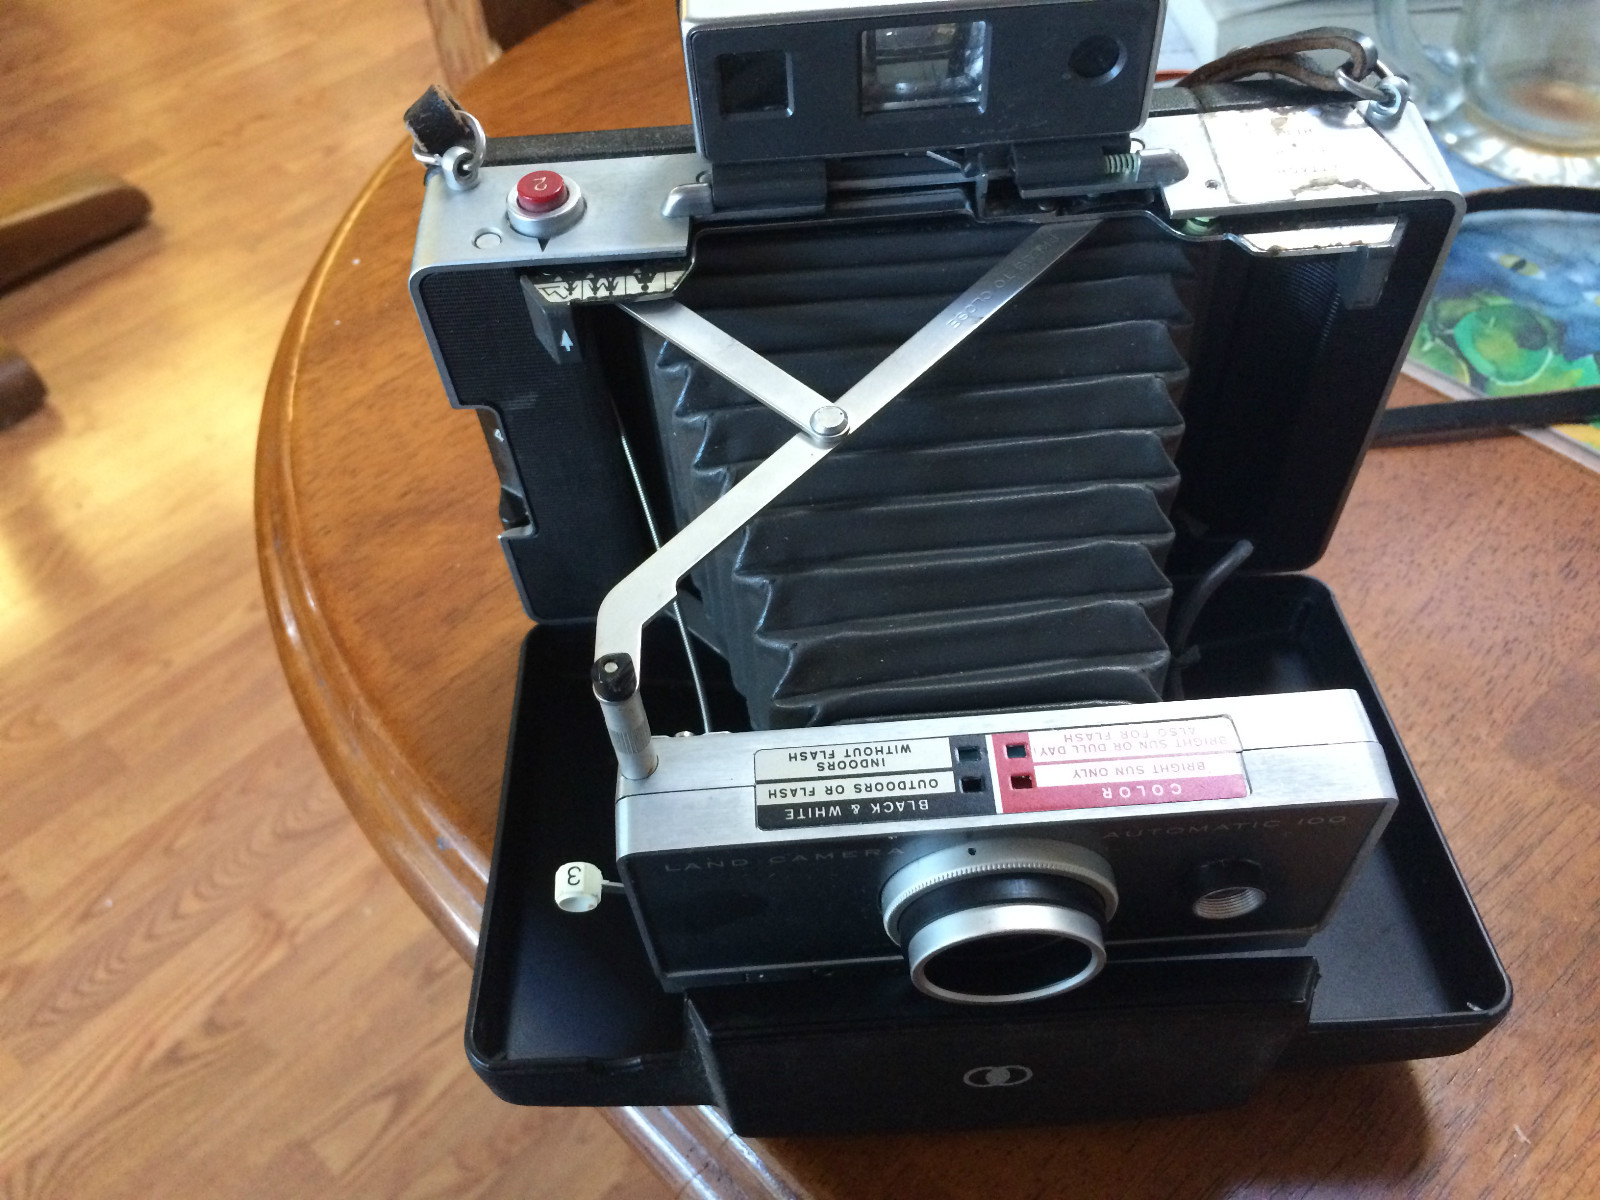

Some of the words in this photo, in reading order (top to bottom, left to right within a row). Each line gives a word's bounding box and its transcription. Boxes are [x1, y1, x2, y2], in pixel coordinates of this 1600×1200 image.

[534, 176, 548, 191] 2
[994, 274, 1016, 289] TO
[946, 290, 993, 329] CLOSE
[1064, 732, 1111, 743] FLASH
[1120, 729, 1149, 740] FOR
[844, 744, 912, 758] WITHOUT
[1074, 743, 1107, 753] DULL
[1113, 741, 1132, 751] OR
[1139, 739, 1168, 750] SUN
[788, 750, 836, 762] FLASH
[816, 757, 886, 771] INDOORS
[1115, 765, 1145, 776] SUN
[1152, 761, 1206, 774] BRIGHT
[1072, 768, 1108, 779] ONLY
[825, 784, 845, 795] OR
[854, 778, 939, 793] OUTDOORS
[1102, 783, 1182, 799] COLOR
[768, 786, 816, 799] FLASH
[784, 805, 842, 820] WHITE
[851, 804, 861, 815] &
[871, 799, 929, 813] BLACK
[1103, 819, 1281, 839] AUTOMATIC
[1298, 815, 1346, 825] 100
[665, 858, 749, 872] LAND
[768, 847, 905, 864] CAMERA
[567, 866, 582, 886] 3
